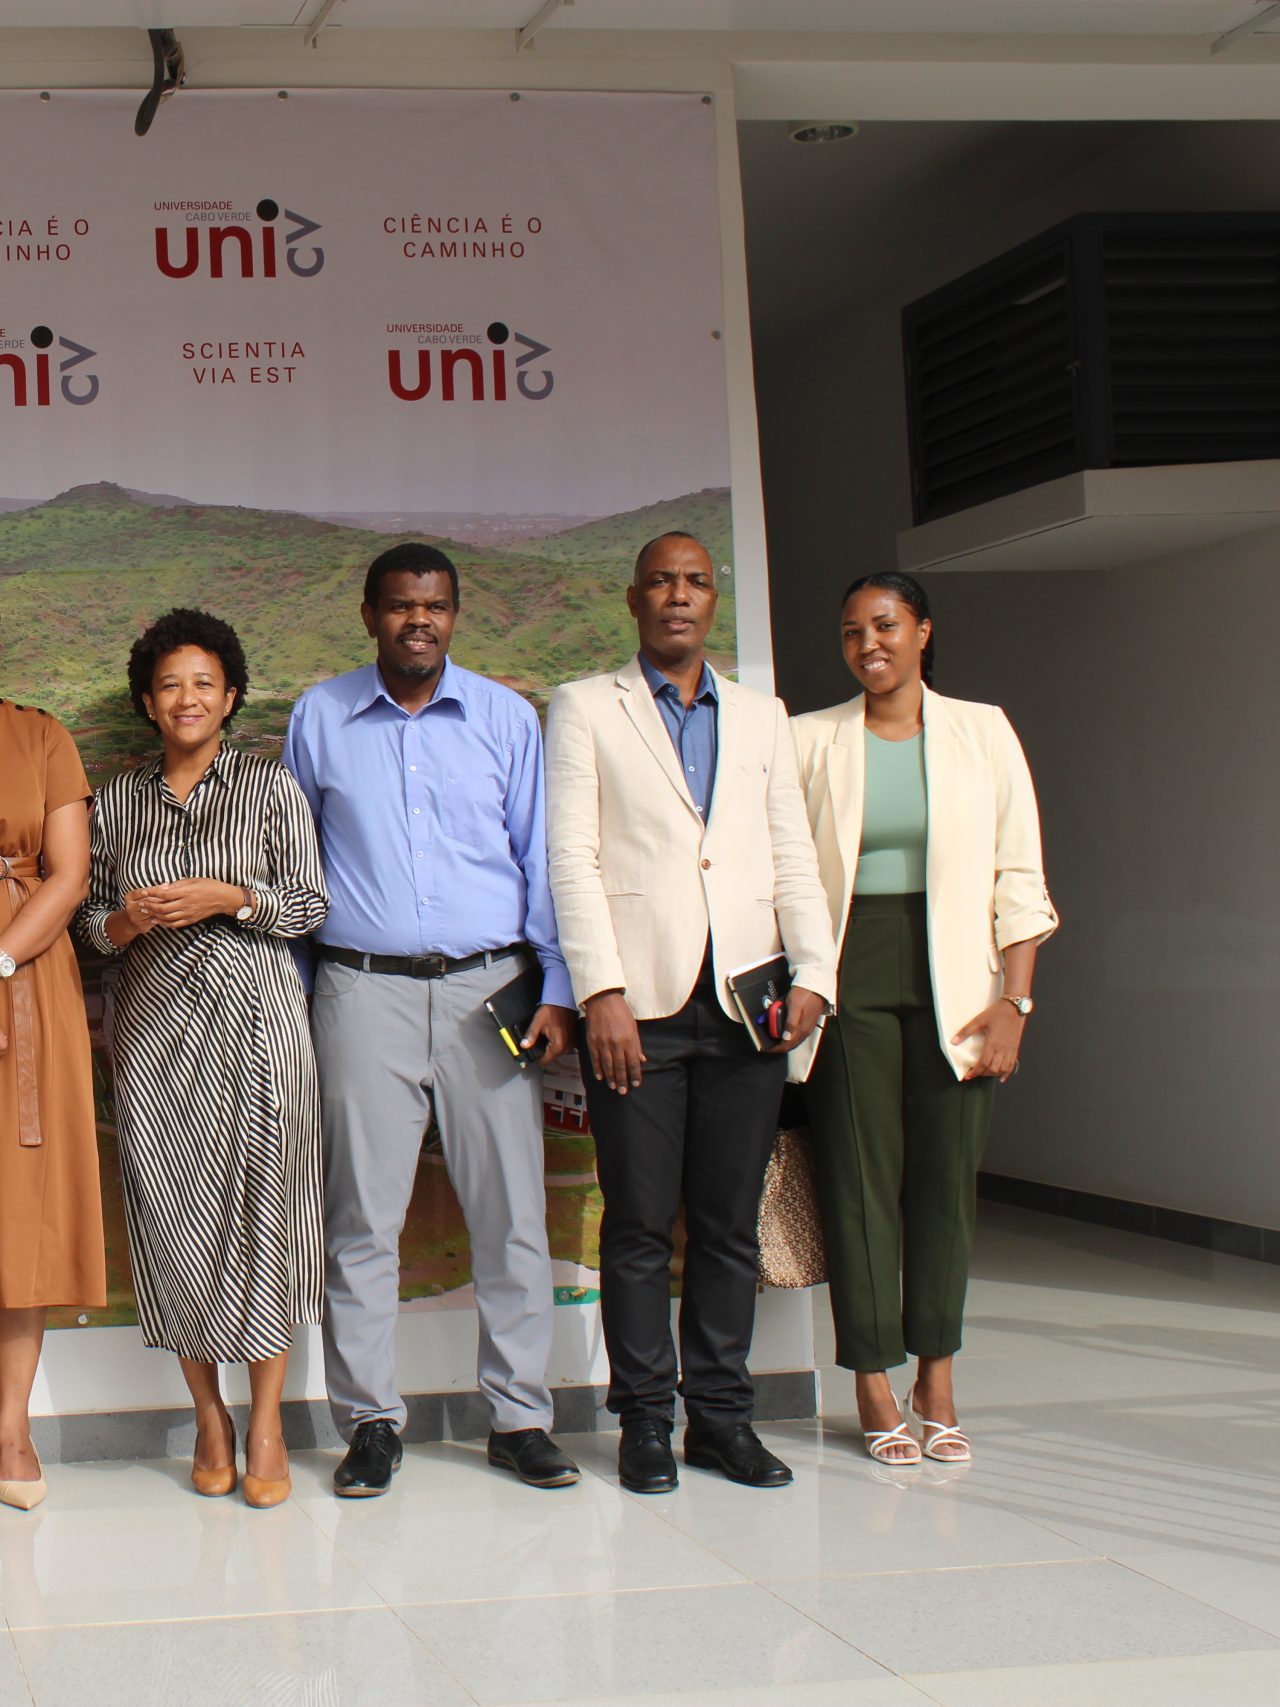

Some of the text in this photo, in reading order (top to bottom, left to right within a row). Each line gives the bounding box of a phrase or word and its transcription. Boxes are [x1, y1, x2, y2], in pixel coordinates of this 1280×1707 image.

[154, 201, 233, 211] UNIVERSIDADE
[47, 215, 58, 237] É
[74, 219, 89, 237] O
[185, 212, 252, 222] CABO VERDE
[383, 213, 542, 234] CIÊNCIA É O
[403, 241, 525, 259] CAMINHO
[387, 324, 464, 334] UNIVERSIDADE
[417, 335, 483, 344] CABO VERDE
[182, 342, 305, 360] SCIENTIA
[193, 367, 296, 385] VIA EST
